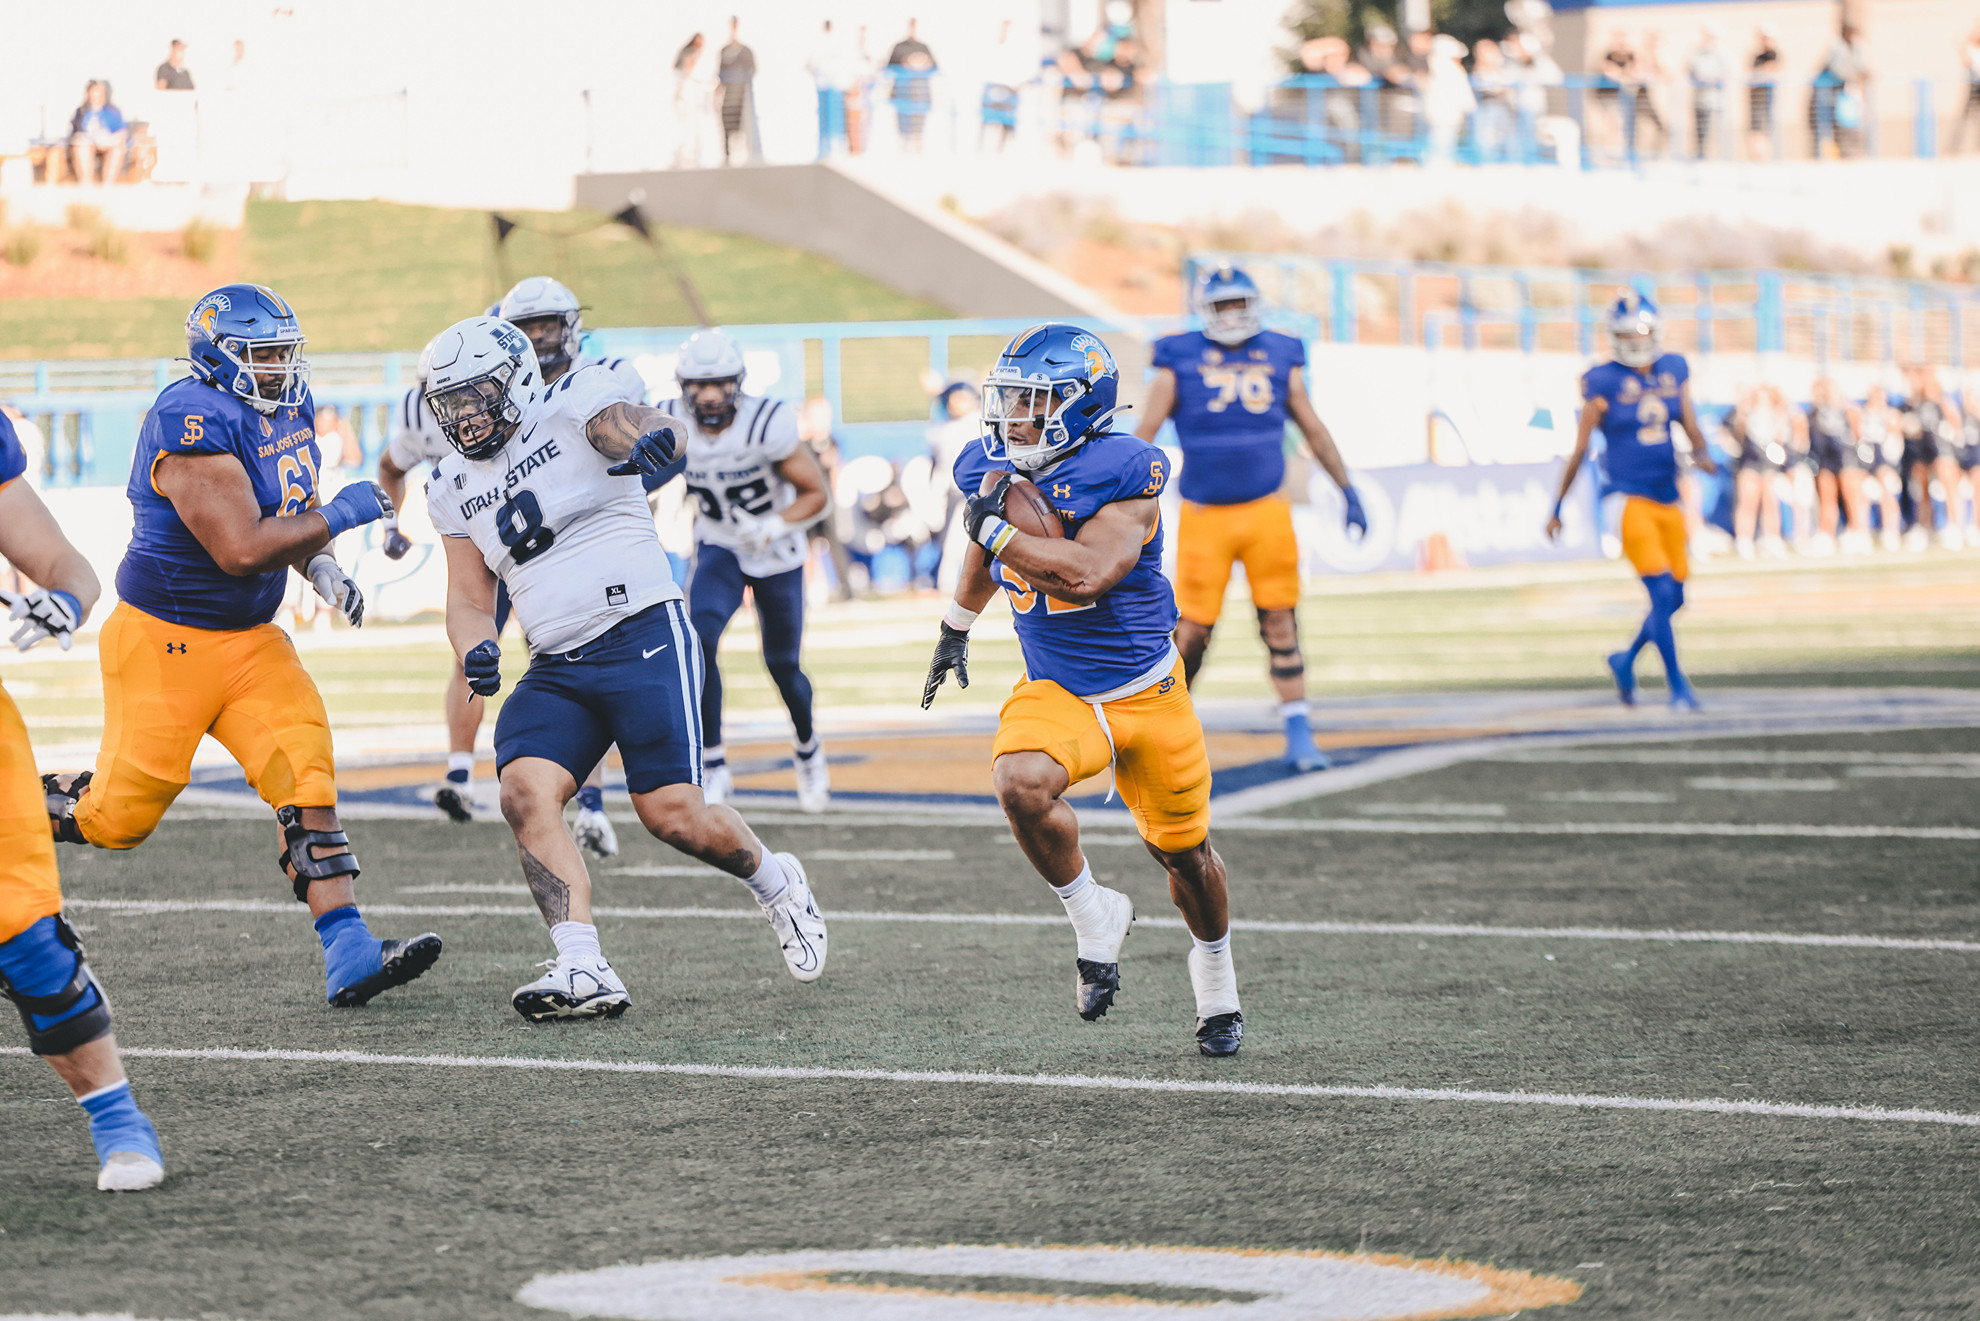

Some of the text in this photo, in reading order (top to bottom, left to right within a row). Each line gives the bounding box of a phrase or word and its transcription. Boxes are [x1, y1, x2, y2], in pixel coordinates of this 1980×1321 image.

[257, 444, 276, 459] SAN
[291, 427, 314, 445] STATE
[460, 438, 562, 521] UTAH STATE
[276, 444, 318, 518] 61
[494, 487, 557, 567] 8
[610, 586, 622, 595] XL
